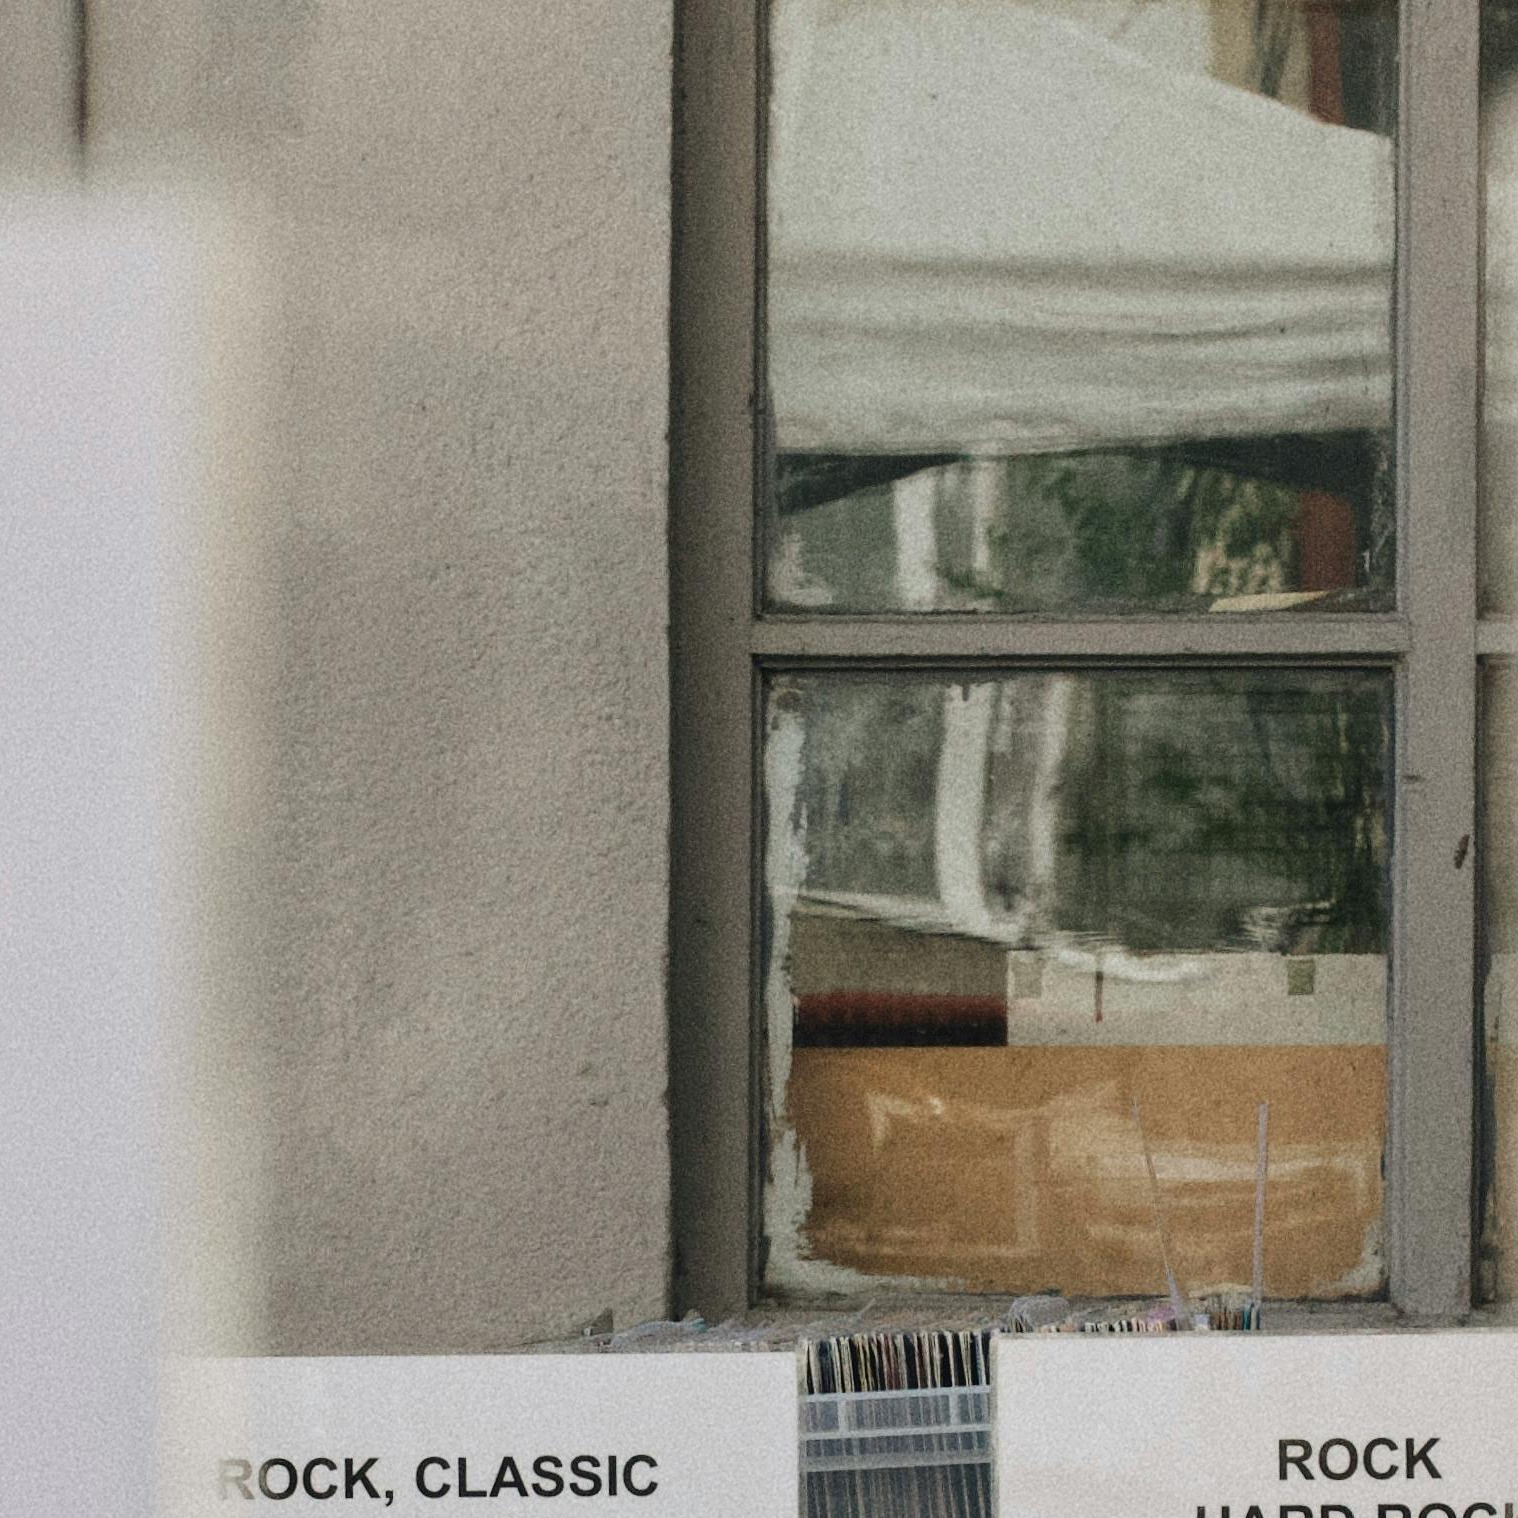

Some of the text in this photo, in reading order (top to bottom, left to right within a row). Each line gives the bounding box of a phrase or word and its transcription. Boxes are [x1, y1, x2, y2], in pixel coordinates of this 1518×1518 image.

[217, 1454, 659, 1507] ROCK, CLASSIC
[1277, 1436, 1442, 1482] ROCK
